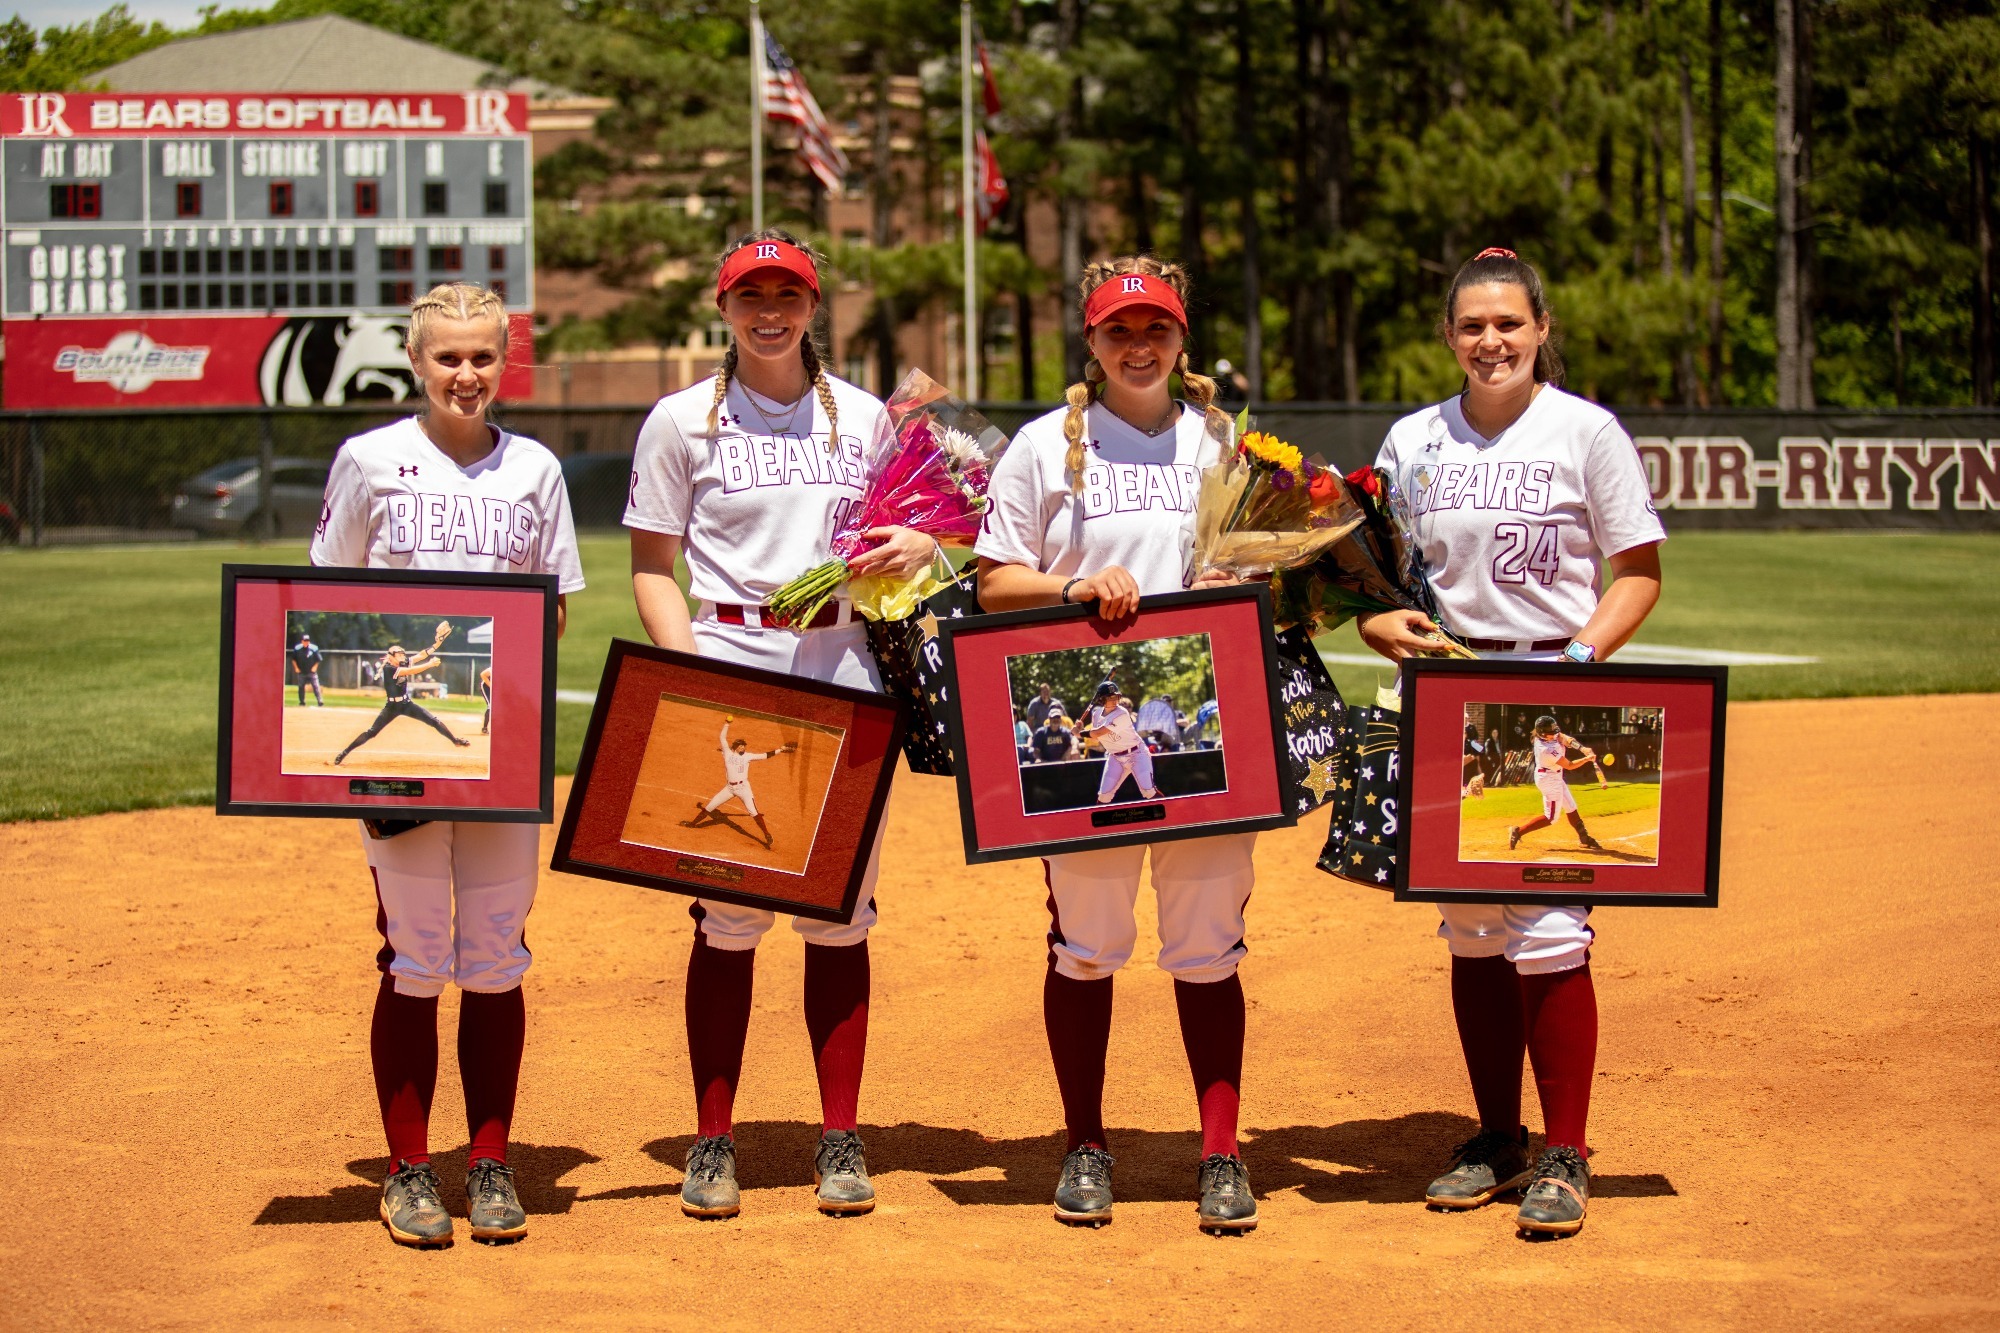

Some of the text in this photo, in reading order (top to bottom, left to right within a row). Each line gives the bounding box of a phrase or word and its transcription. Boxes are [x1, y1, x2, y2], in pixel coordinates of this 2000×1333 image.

[18, 92, 73, 138] LR
[90, 98, 446, 129] BEARS SOFTBALL
[461, 89, 516, 136] LR
[41, 141, 114, 178] AT BAT
[162, 141, 215, 178] BALL
[241, 141, 320, 178] STRIKE
[343, 141, 388, 177] OUT
[143, 225, 152, 246] 1
[164, 225, 175, 246] 2
[756, 244, 781, 260] LR
[30, 244, 126, 280] GUEST
[30, 279, 127, 314] BEARS
[1121, 277, 1147, 294] LR
[716, 433, 865, 493] BEARS
[1082, 463, 1202, 521] BEAR
[1409, 461, 1555, 518] BEARS
[387, 493, 533, 566] BEARS
[1493, 523, 1560, 585] 24
